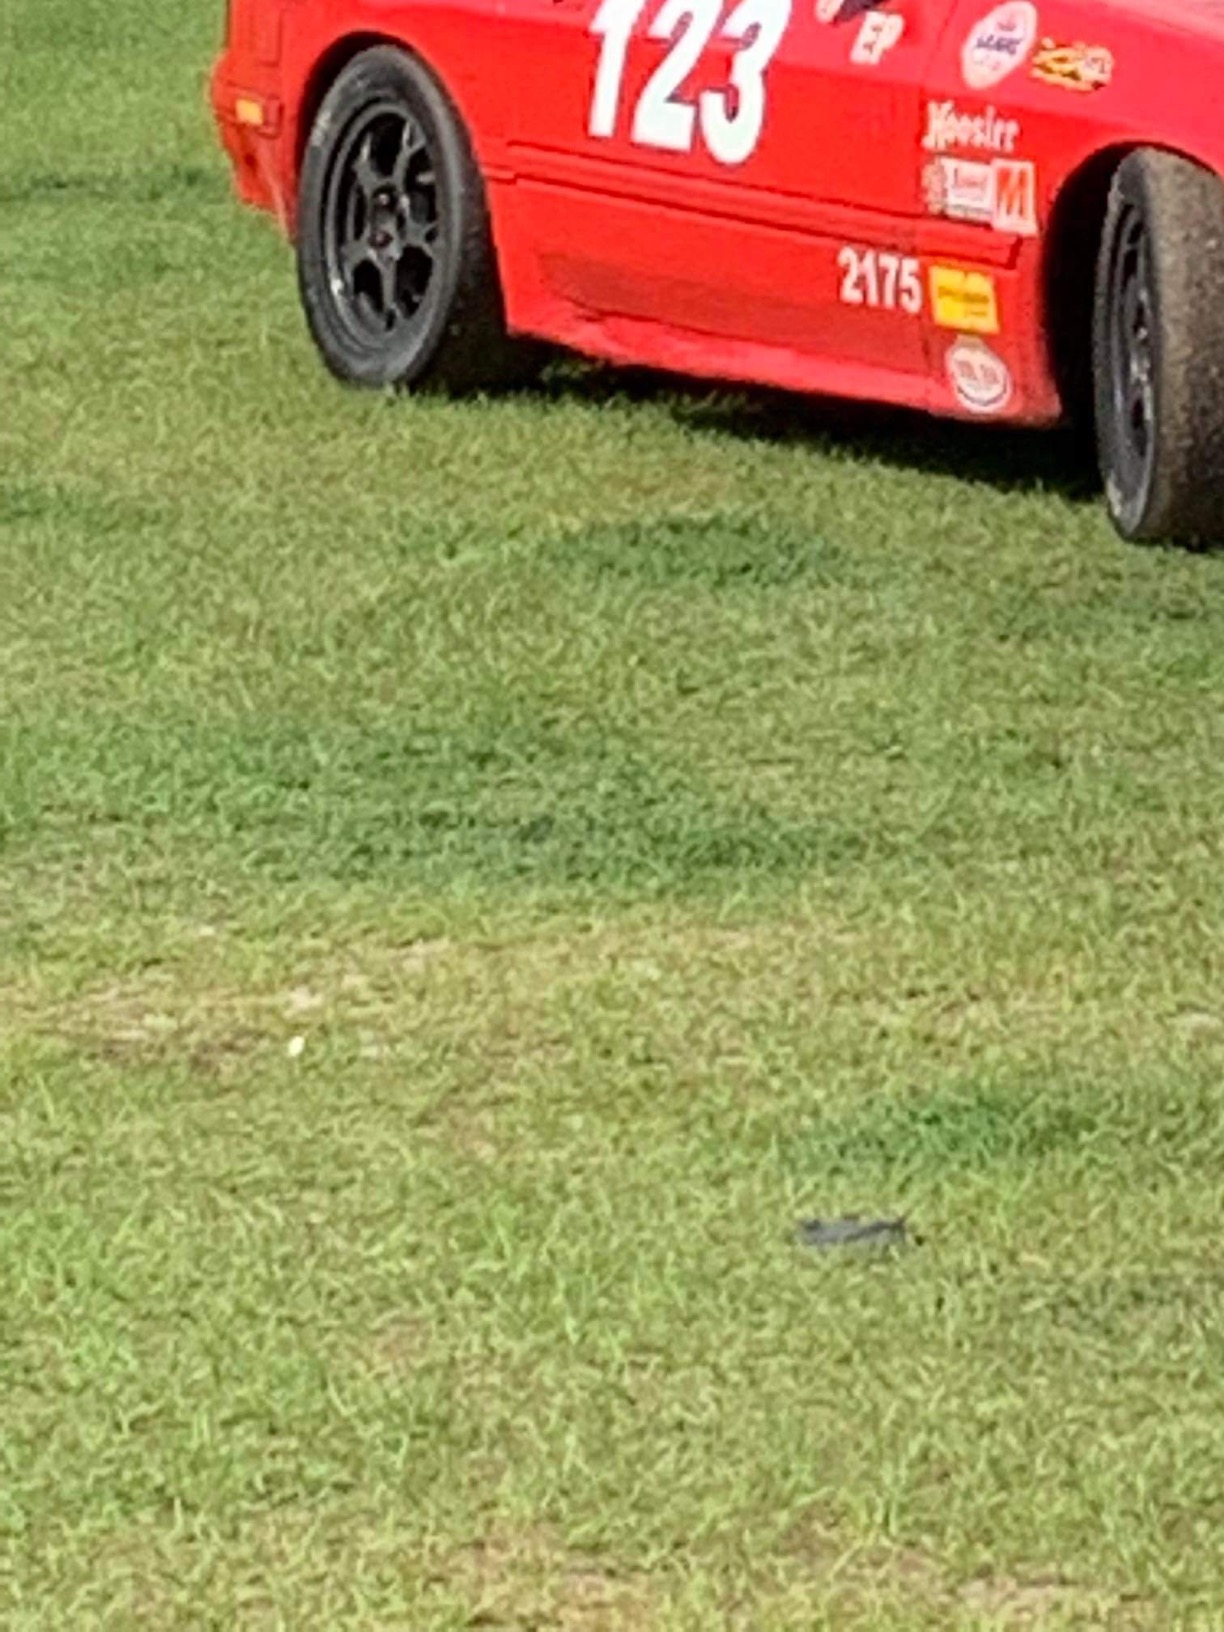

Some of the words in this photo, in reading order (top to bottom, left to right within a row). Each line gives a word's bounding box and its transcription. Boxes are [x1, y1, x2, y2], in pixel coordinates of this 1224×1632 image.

[850, 11, 904, 64] EP
[921, 100, 1019, 152] Hoosier
[838, 245, 923, 313] 2175
